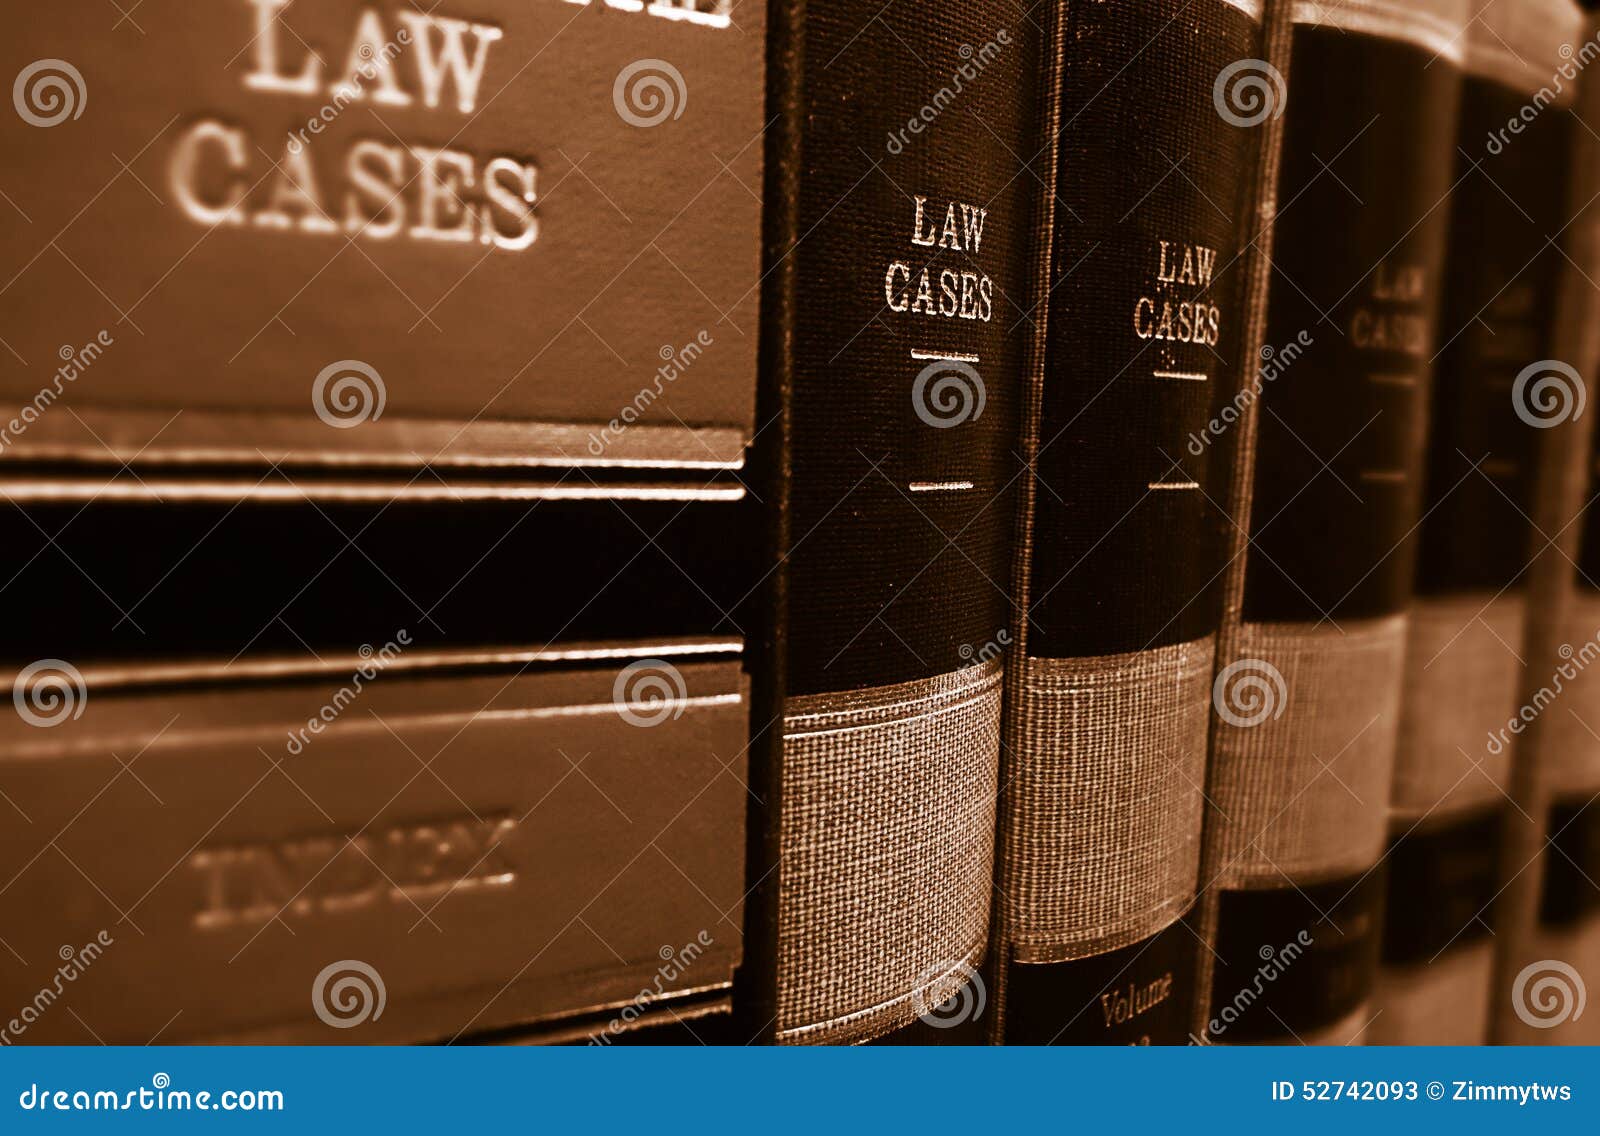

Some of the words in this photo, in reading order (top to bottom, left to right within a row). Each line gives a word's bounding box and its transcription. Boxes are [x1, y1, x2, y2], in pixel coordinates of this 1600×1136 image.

[244, 0, 503, 114] LAW
[169, 118, 540, 251] CASES
[911, 195, 987, 253] LAW
[884, 260, 993, 322] CASES
[1157, 240, 1216, 288] LAW
[1133, 297, 1220, 347] CASES
[191, 815, 516, 929] INDEX
[1101, 972, 1173, 1027] Volume
